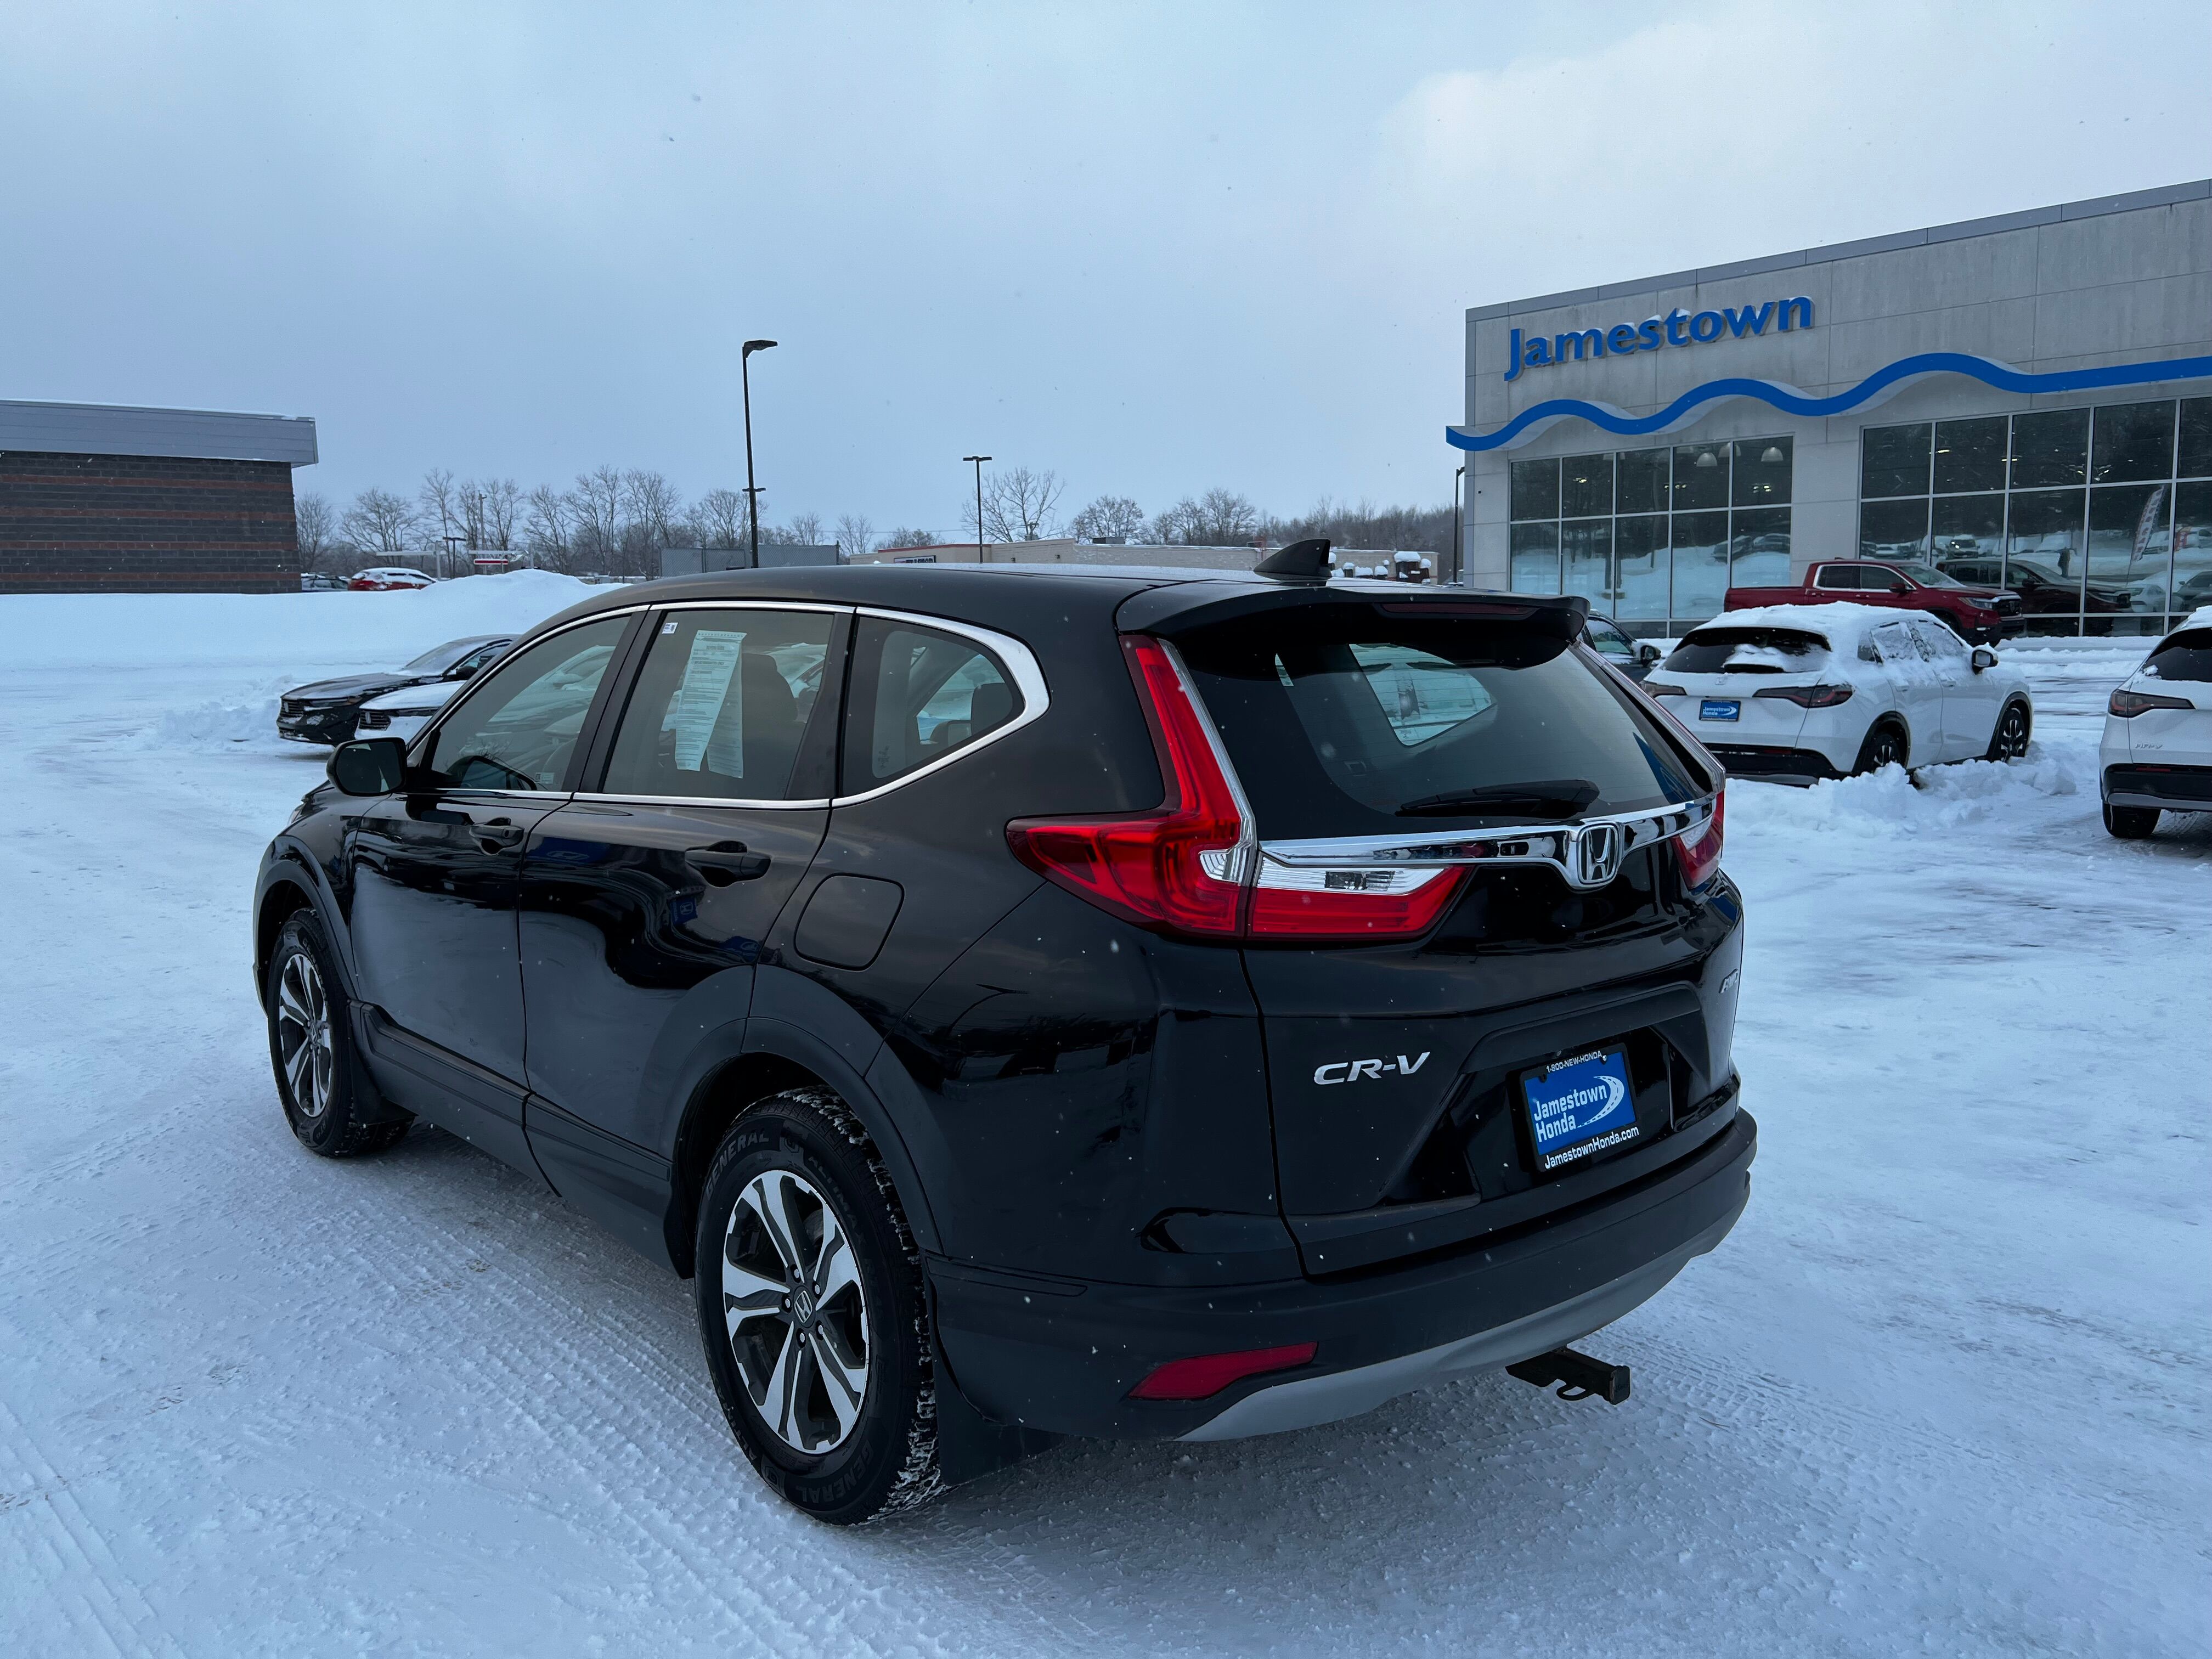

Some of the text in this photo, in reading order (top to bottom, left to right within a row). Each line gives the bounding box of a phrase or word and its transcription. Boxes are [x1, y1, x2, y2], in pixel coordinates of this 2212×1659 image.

[1504, 295, 1813, 381] Jamestown
[1314, 1052, 1430, 1085] CR-V
[1546, 1050, 1602, 1073] 1-800-NEW-HONDA
[1534, 1085, 1607, 1121] Jamestown
[1536, 1112, 1577, 1143] Honda
[706, 1130, 769, 1200] GENERAL
[1544, 1126, 1639, 1169] JamestownHonda.com
[795, 1439, 874, 1504] GENERAL
